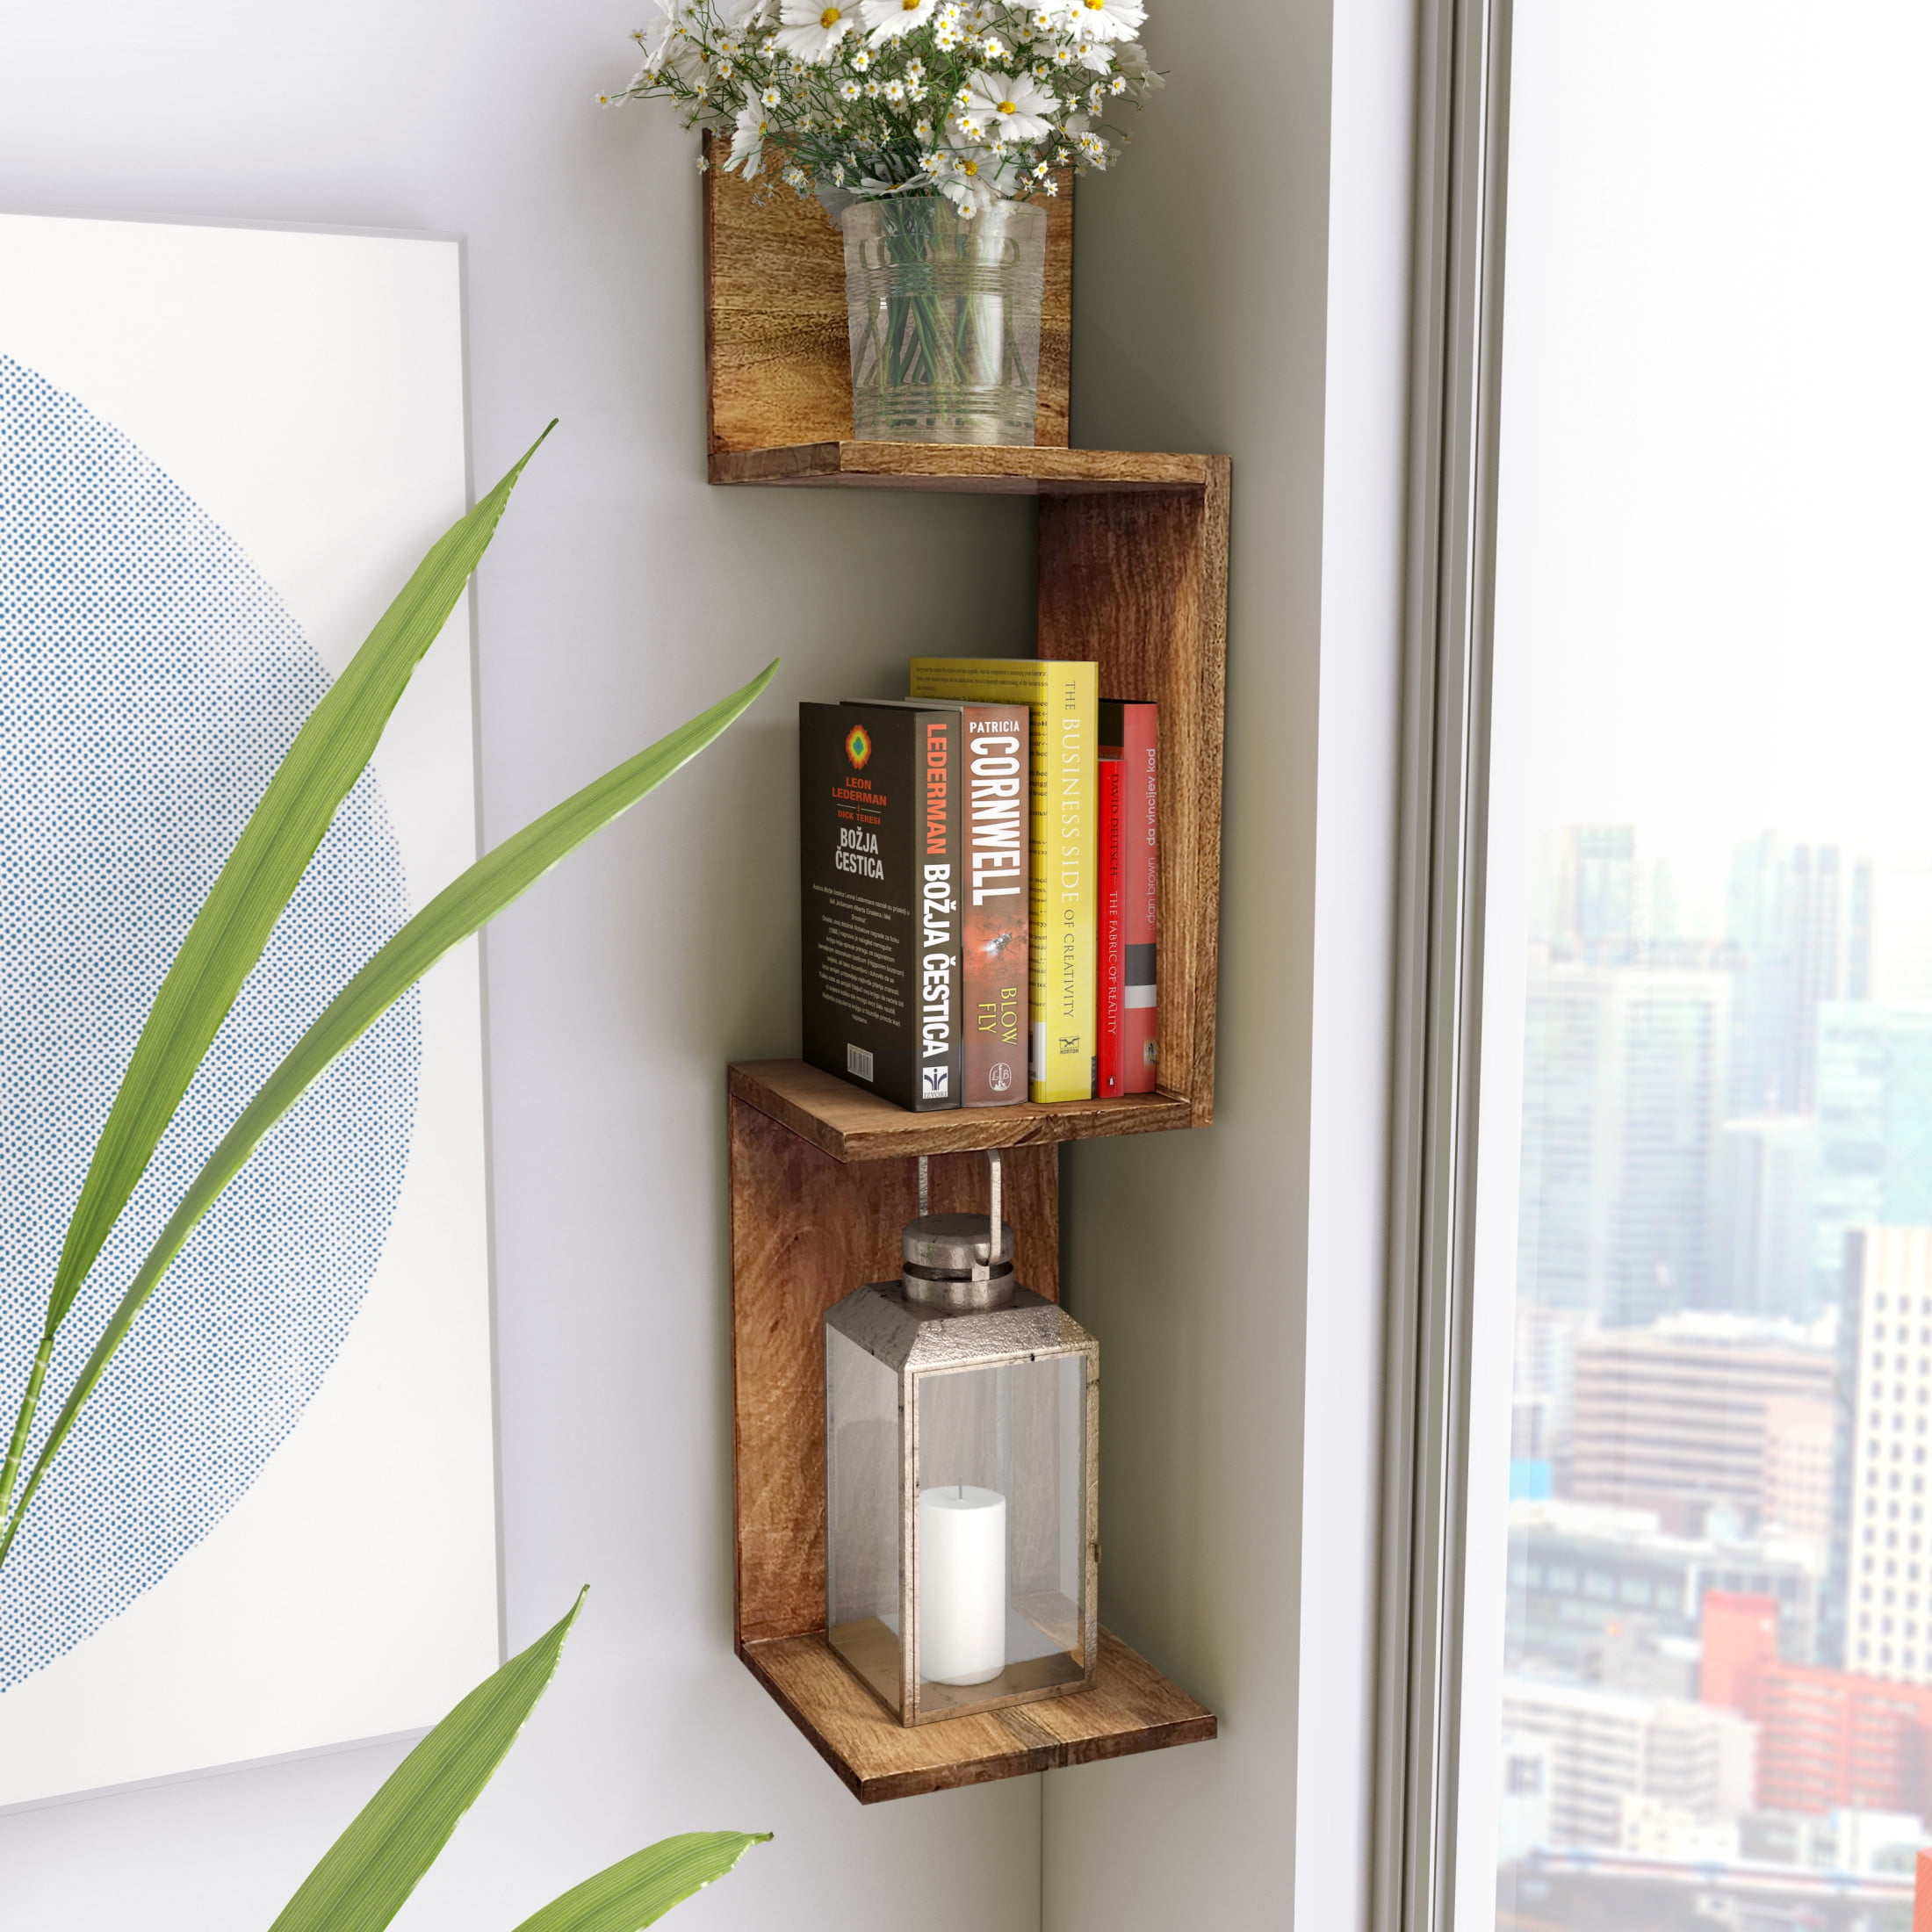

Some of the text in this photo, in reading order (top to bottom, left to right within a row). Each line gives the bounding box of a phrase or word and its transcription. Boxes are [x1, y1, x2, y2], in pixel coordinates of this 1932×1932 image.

[969, 720, 1020, 733] PATRICIA
[832, 787, 887, 806] LEDERMAN
[846, 776, 872, 790] LEON
[837, 810, 881, 825] DICK TERESI
[970, 736, 1020, 906] CORNWELL
[1147, 748, 1157, 924] dan brown da vincijev kod
[840, 825, 879, 855] BOŽJA
[1062, 680, 1080, 1018] THE BUSINESS SIDE OF CREATIVITY
[1110, 818, 1119, 876] DEUTSCH
[835, 845, 884, 881] ČESTICA
[922, 723, 956, 1058] LEDERMAN BOŽJA ČESTICA
[1109, 919, 1118, 962] FABRIC
[1109, 966, 1118, 984] OF
[977, 1003, 997, 1034] FLY
[1000, 987, 1018, 1045] BLOW
[1108, 984, 1117, 1034] REALITY
